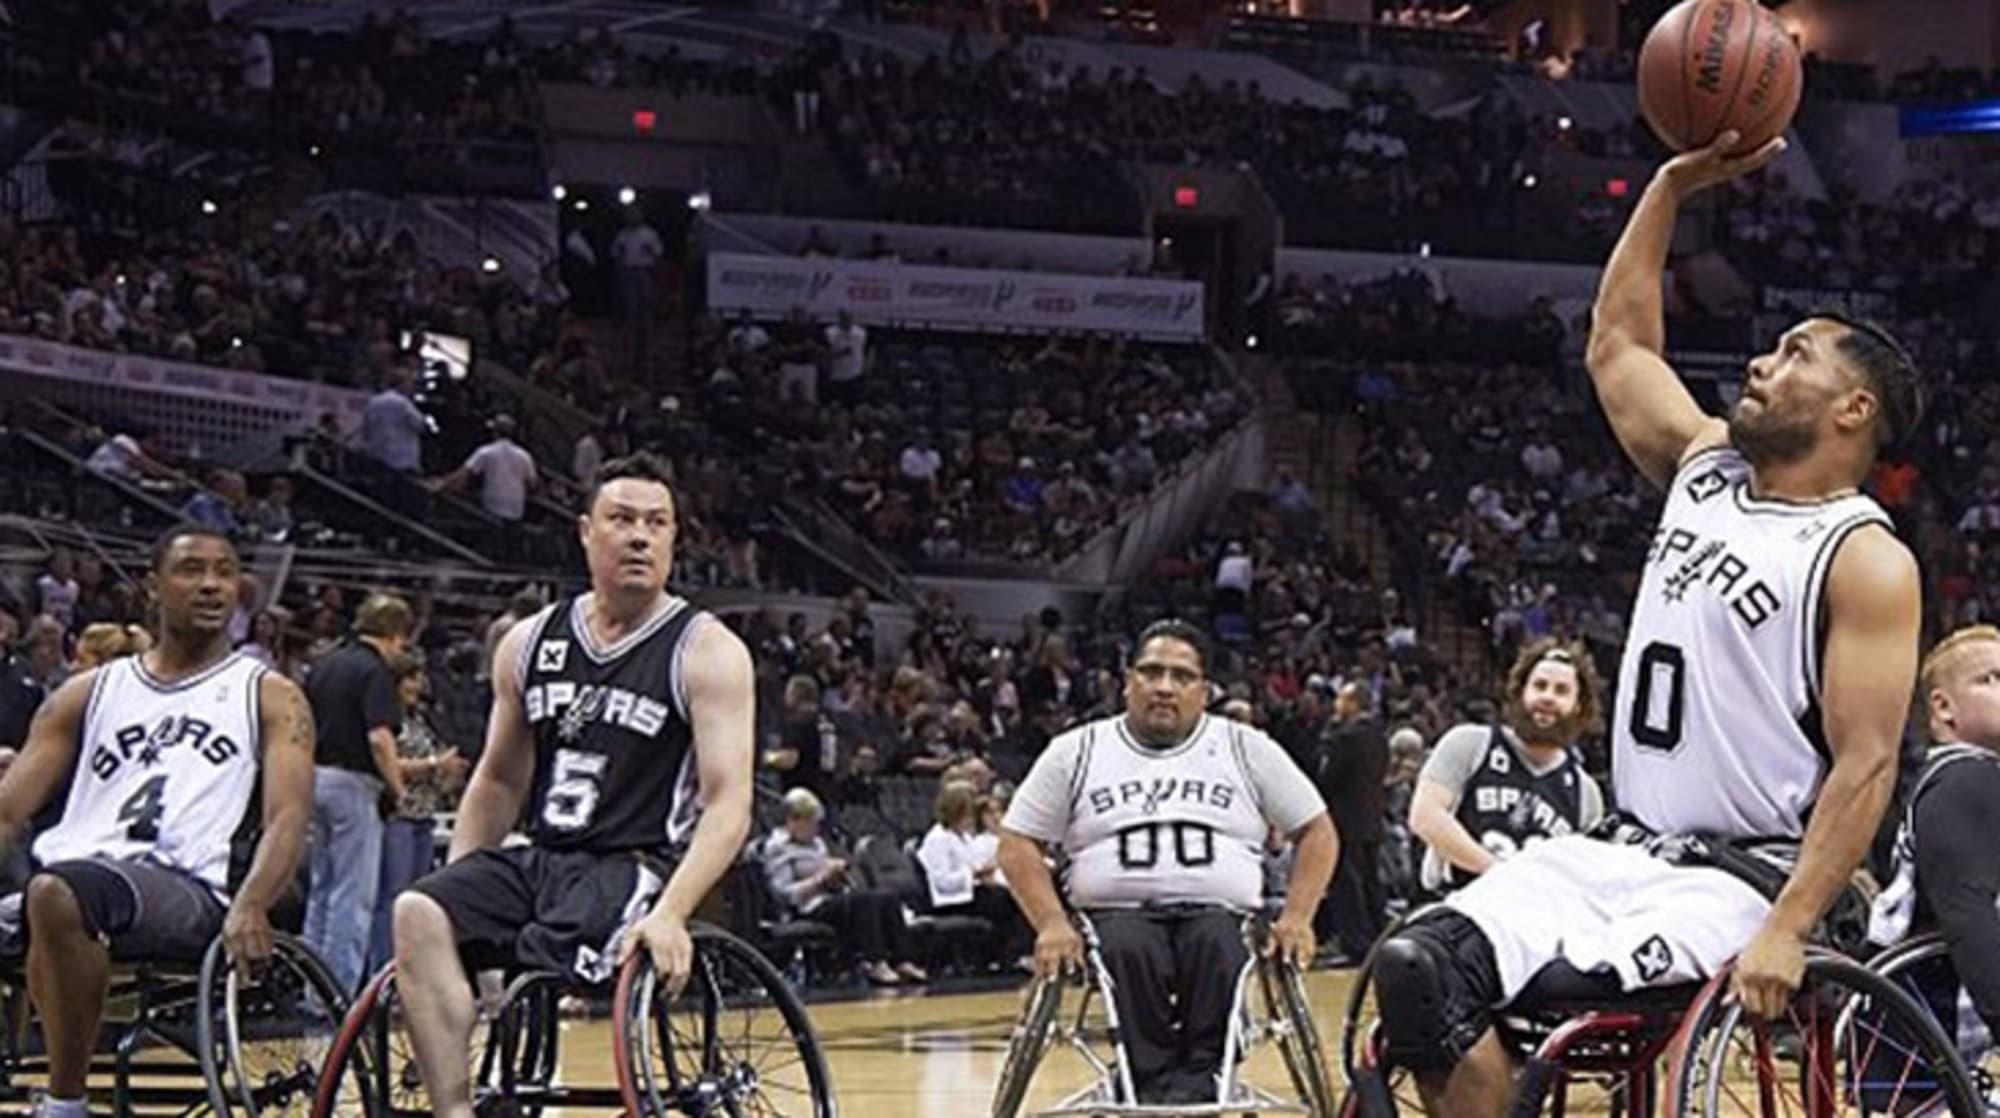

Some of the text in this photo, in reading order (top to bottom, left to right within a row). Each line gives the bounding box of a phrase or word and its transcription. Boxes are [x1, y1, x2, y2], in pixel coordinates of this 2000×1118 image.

[526, 682, 669, 739] SPURS
[1629, 640, 1685, 752] 0
[92, 714, 238, 780] SPURS
[116, 774, 169, 842] 4
[543, 748, 607, 829] 5
[1090, 777, 1235, 815] SPURS
[1118, 820, 1215, 870] 00
